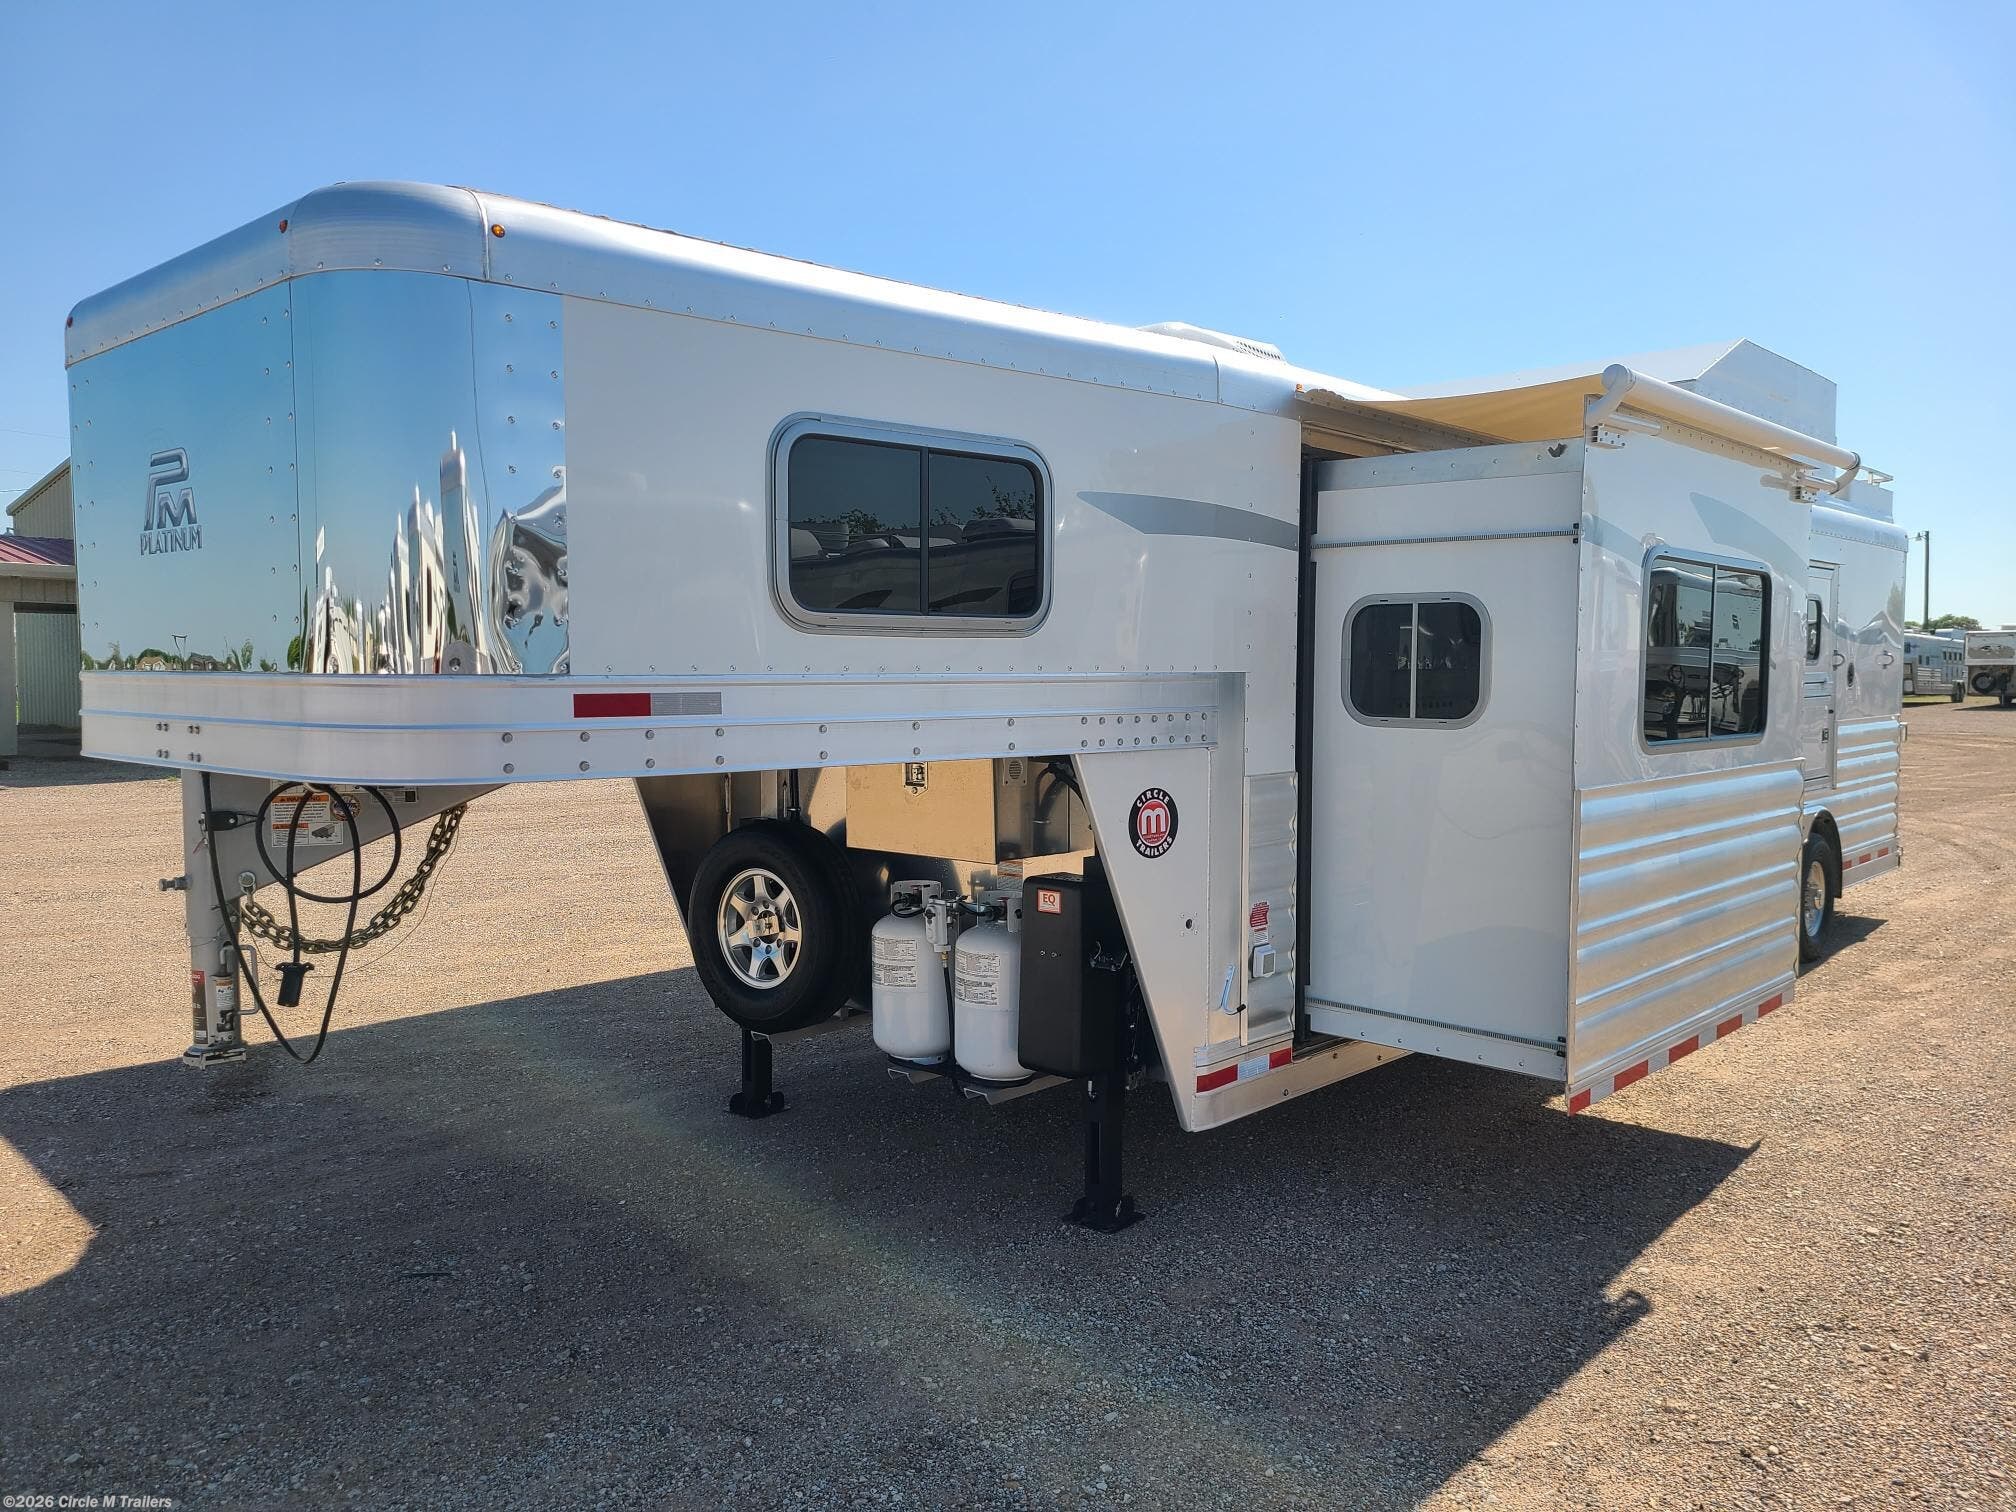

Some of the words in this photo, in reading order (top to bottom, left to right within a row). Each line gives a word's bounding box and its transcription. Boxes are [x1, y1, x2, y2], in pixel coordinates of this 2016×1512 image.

[140, 525, 203, 556] PLATINUM
[1136, 789, 1170, 808] CIRCLE
[1136, 836, 1172, 856] TRAILERS
[1042, 893, 1056, 906] EQ
